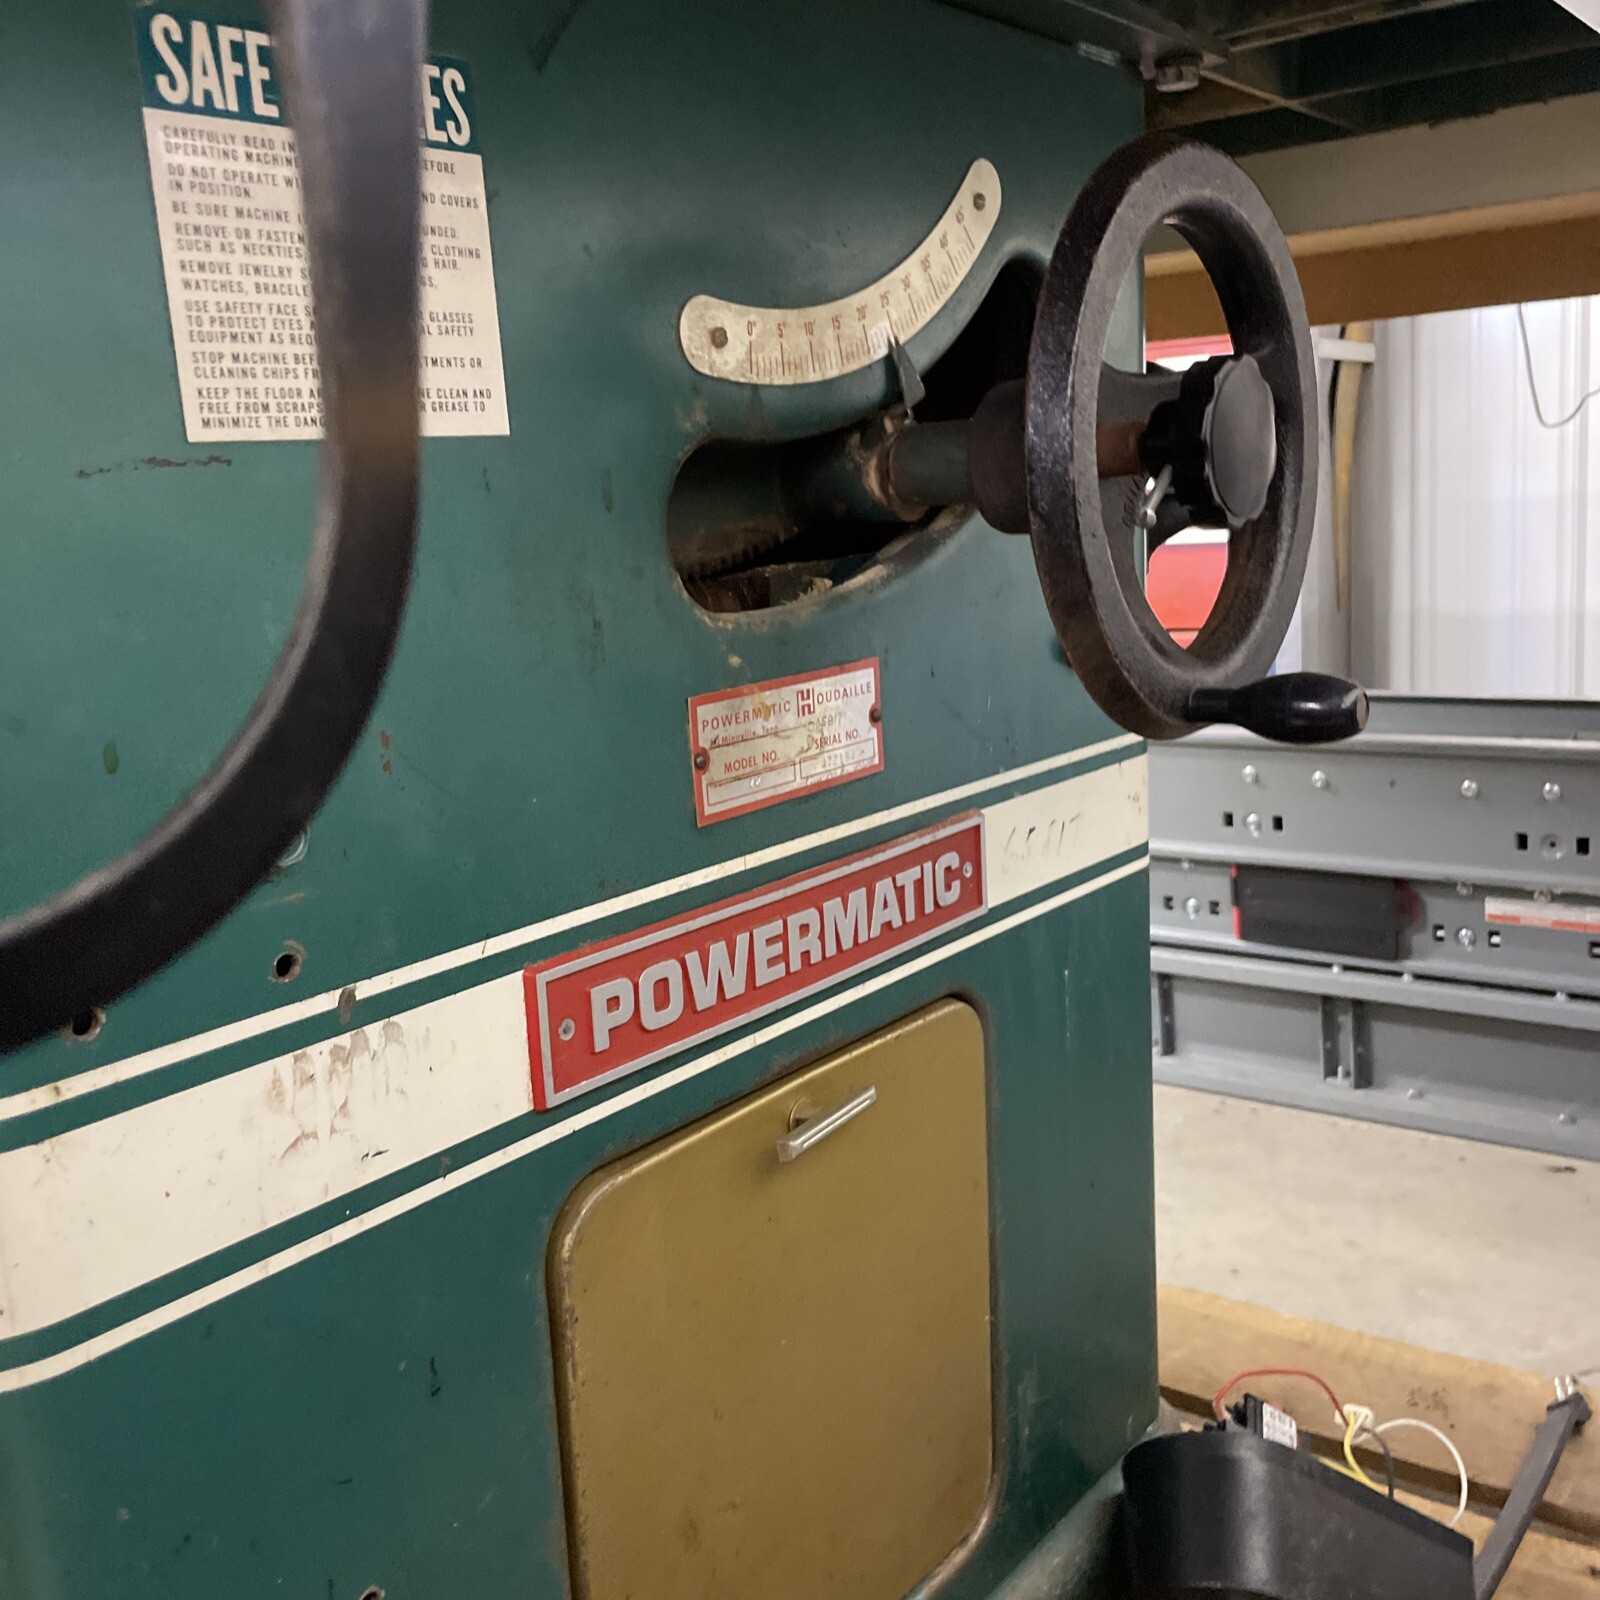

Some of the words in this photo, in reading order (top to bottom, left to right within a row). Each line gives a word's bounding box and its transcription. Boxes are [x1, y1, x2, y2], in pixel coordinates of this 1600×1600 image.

[150, 13, 280, 119] SAFE
[420, 63, 471, 147] ES
[163, 124, 236, 147] CAREFULLY
[244, 135, 275, 150] READ
[421, 159, 456, 175] EFORE
[164, 140, 239, 162] OPERATING
[167, 162, 185, 177] DO
[191, 165, 216, 180] NOT
[222, 168, 280, 186] OPERATE
[421, 191, 436, 205] ND
[440, 193, 479, 209] COVERS
[169, 179, 183, 192] IN
[172, 200, 188, 215] BE
[196, 202, 229, 218] SURE
[235, 206, 291, 224] MACHINE
[174, 222, 227, 239] REMOVE
[235, 227, 251, 240] OR
[258, 229, 306, 245] FASTEN
[431, 244, 481, 259] CLOTHING
[176, 238, 212, 253] SUCH
[219, 242, 236, 255] AS
[179, 259, 232, 276] REMOVE
[239, 262, 293, 280] JEWELRY
[182, 277, 249, 296] WATCHES,
[255, 281, 310, 298] BRACELE
[184, 299, 210, 313] USE
[215, 300, 262, 315] SAFETY
[268, 303, 299, 316] FACE
[429, 311, 473, 324] GLASSES
[186, 315, 204, 328] TO
[209, 316, 266, 330] PROTECT
[273, 318, 303, 331] EYES
[438, 325, 474, 337] SAFETY
[189, 330, 263, 344] EQUIPMENT
[269, 332, 284, 345] AS
[289, 333, 314, 346] REQ
[191, 351, 225, 364] STOP
[231, 352, 287, 366] MACHINE
[293, 353, 317, 367] BEF
[423, 356, 466, 369] TMENTS
[470, 357, 482, 369] OR
[194, 366, 257, 379] CLEANING
[262, 367, 299, 380] CHIPS
[196, 387, 230, 400] KEEP
[235, 387, 259, 400] THE
[265, 387, 303, 400] FLOOR
[437, 388, 468, 400] CLEAN
[473, 388, 492, 400] AND
[199, 402, 231, 415] FREE
[236, 402, 270, 414] FROM
[276, 402, 324, 415] SCRAPS
[432, 401, 469, 413] GREASE
[473, 401, 485, 413] TO
[201, 416, 262, 430] MINIMIZE
[266, 416, 290, 429] THE
[702, 700, 791, 733] POWERMTIC
[815, 732, 842, 750] SERIAL
[724, 755, 758, 774] MODEL
[762, 749, 780, 764] NO.
[590, 850, 962, 1054] POWERMATIC
